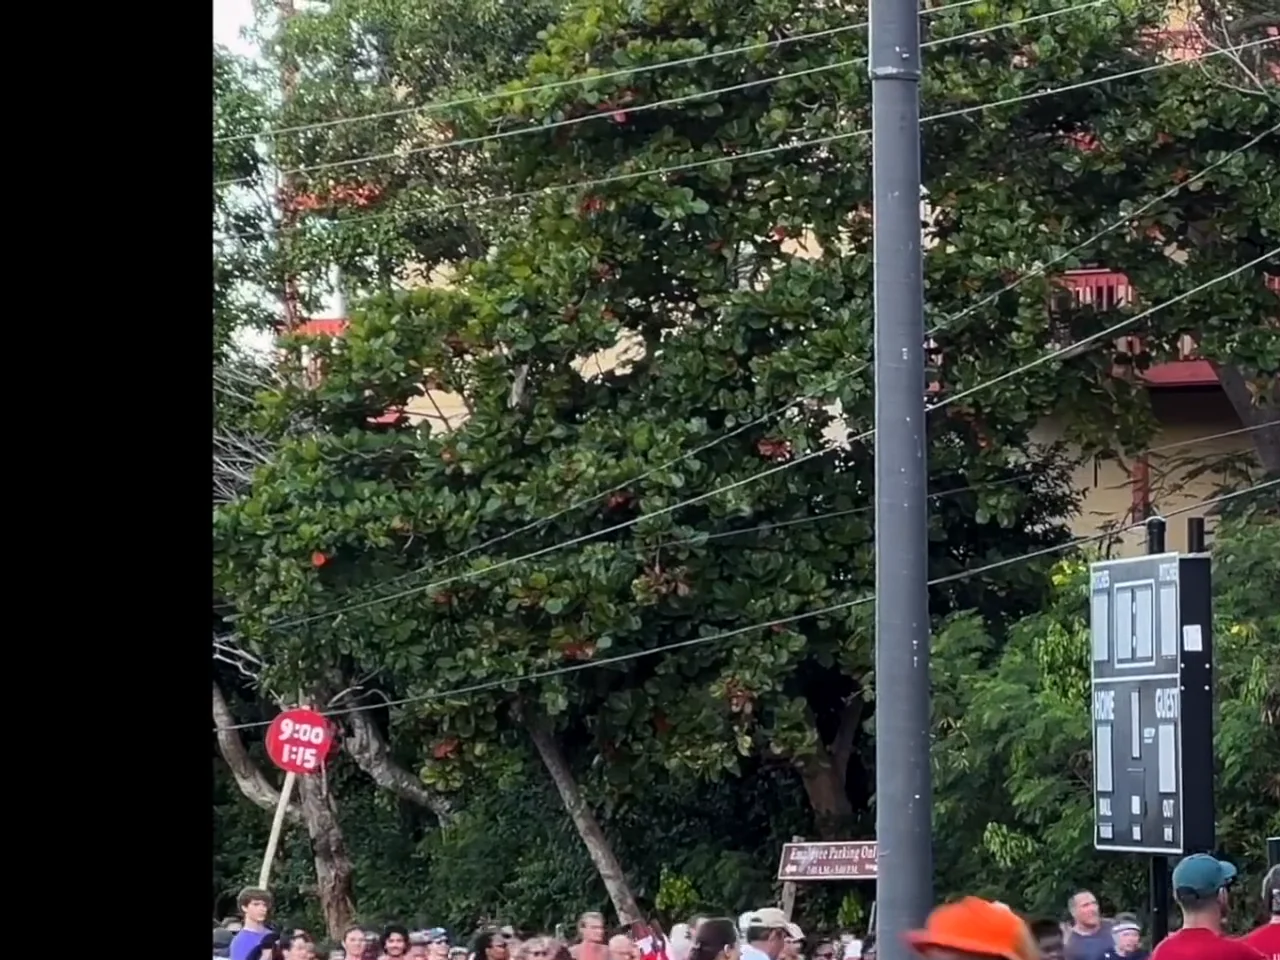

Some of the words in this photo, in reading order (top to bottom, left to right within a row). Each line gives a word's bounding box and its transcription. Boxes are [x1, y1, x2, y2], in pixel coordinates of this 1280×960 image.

[1155, 688, 1179, 718] GUEST
[278, 718, 324, 744] 9:00
[282, 744, 317, 768] 1:15
[828, 845, 860, 862] Parking
[861, 845, 878, 861] Onl
